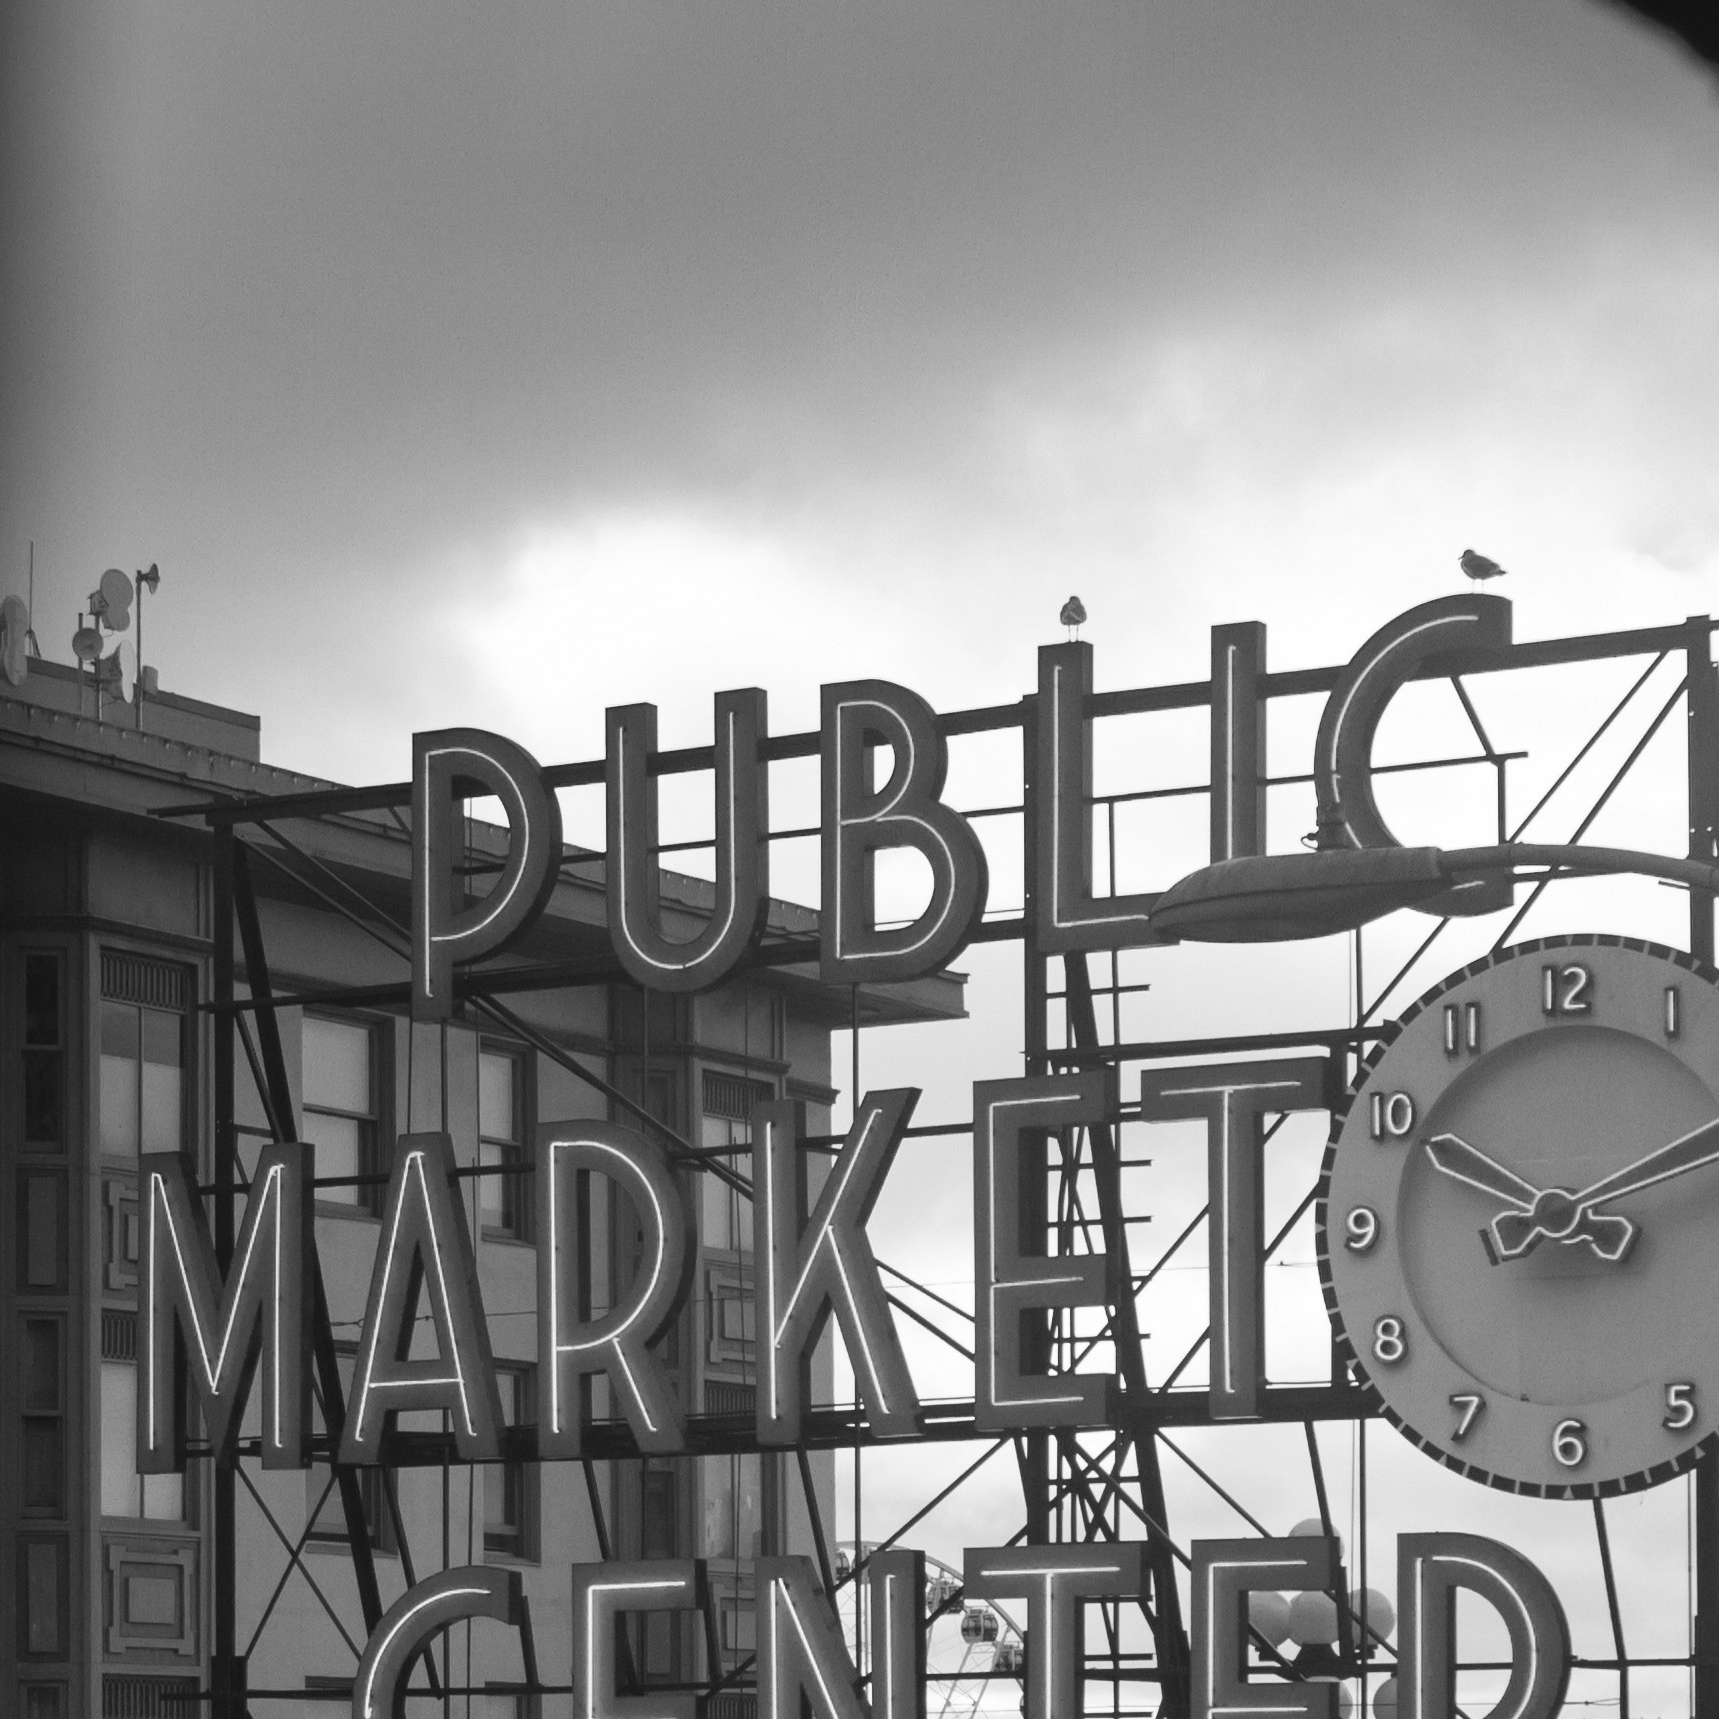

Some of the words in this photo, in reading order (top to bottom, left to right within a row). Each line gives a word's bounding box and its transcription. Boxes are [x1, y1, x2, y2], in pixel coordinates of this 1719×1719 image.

[412, 594, 1512, 1020] PUBLIC
[1541, 966, 1592, 1014] 12
[1665, 988, 1677, 1037] 1
[1443, 1003, 1481, 1054] 11
[1370, 1091, 1414, 1140] 10
[1345, 1208, 1378, 1252] 9
[138, 1055, 1342, 1475] MARKET
[1372, 1317, 1407, 1364] 8
[1450, 1394, 1483, 1440] 7
[1663, 1383, 1696, 1430] 5
[1551, 1420, 1587, 1467] 6
